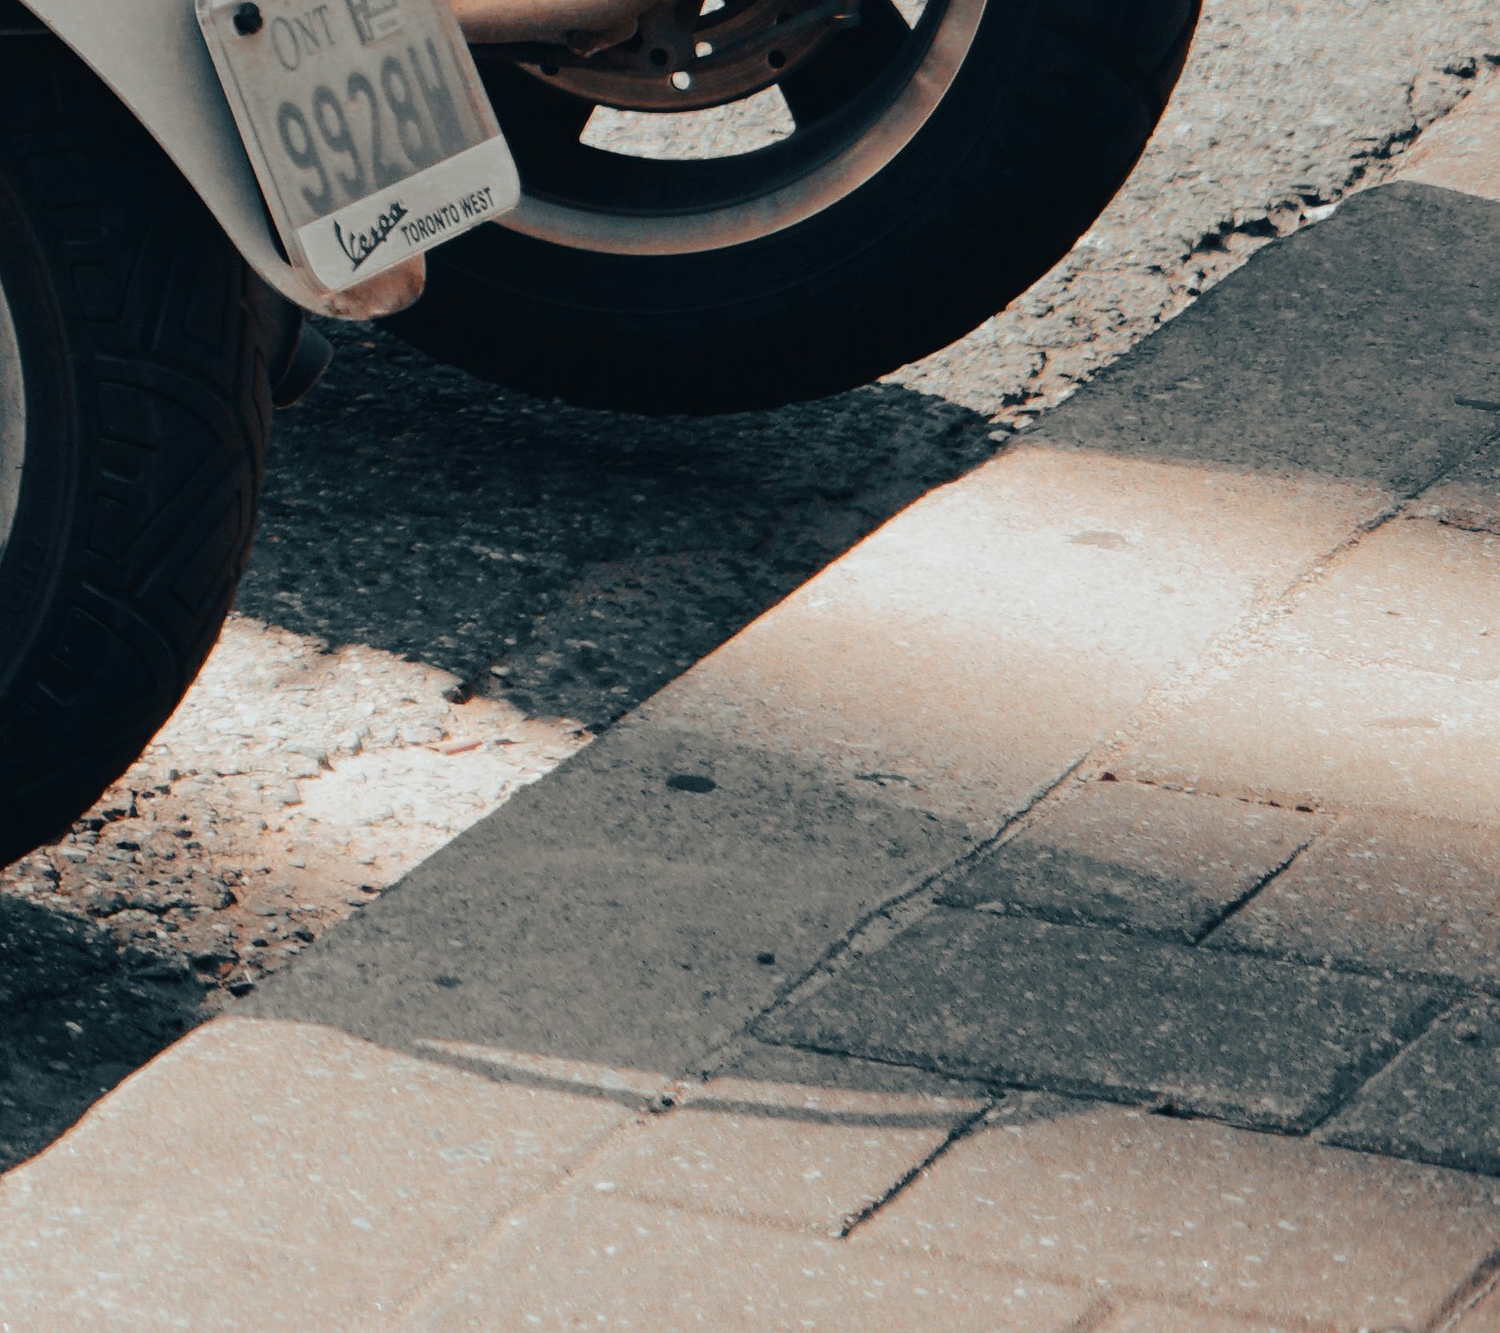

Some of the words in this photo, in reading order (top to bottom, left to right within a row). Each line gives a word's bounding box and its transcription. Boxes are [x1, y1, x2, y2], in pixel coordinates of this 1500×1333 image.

[269, 4, 335, 71] ONT
[333, 200, 409, 272] Vespa
[401, 202, 461, 247] TORONTO
[460, 186, 496, 222] WEST
